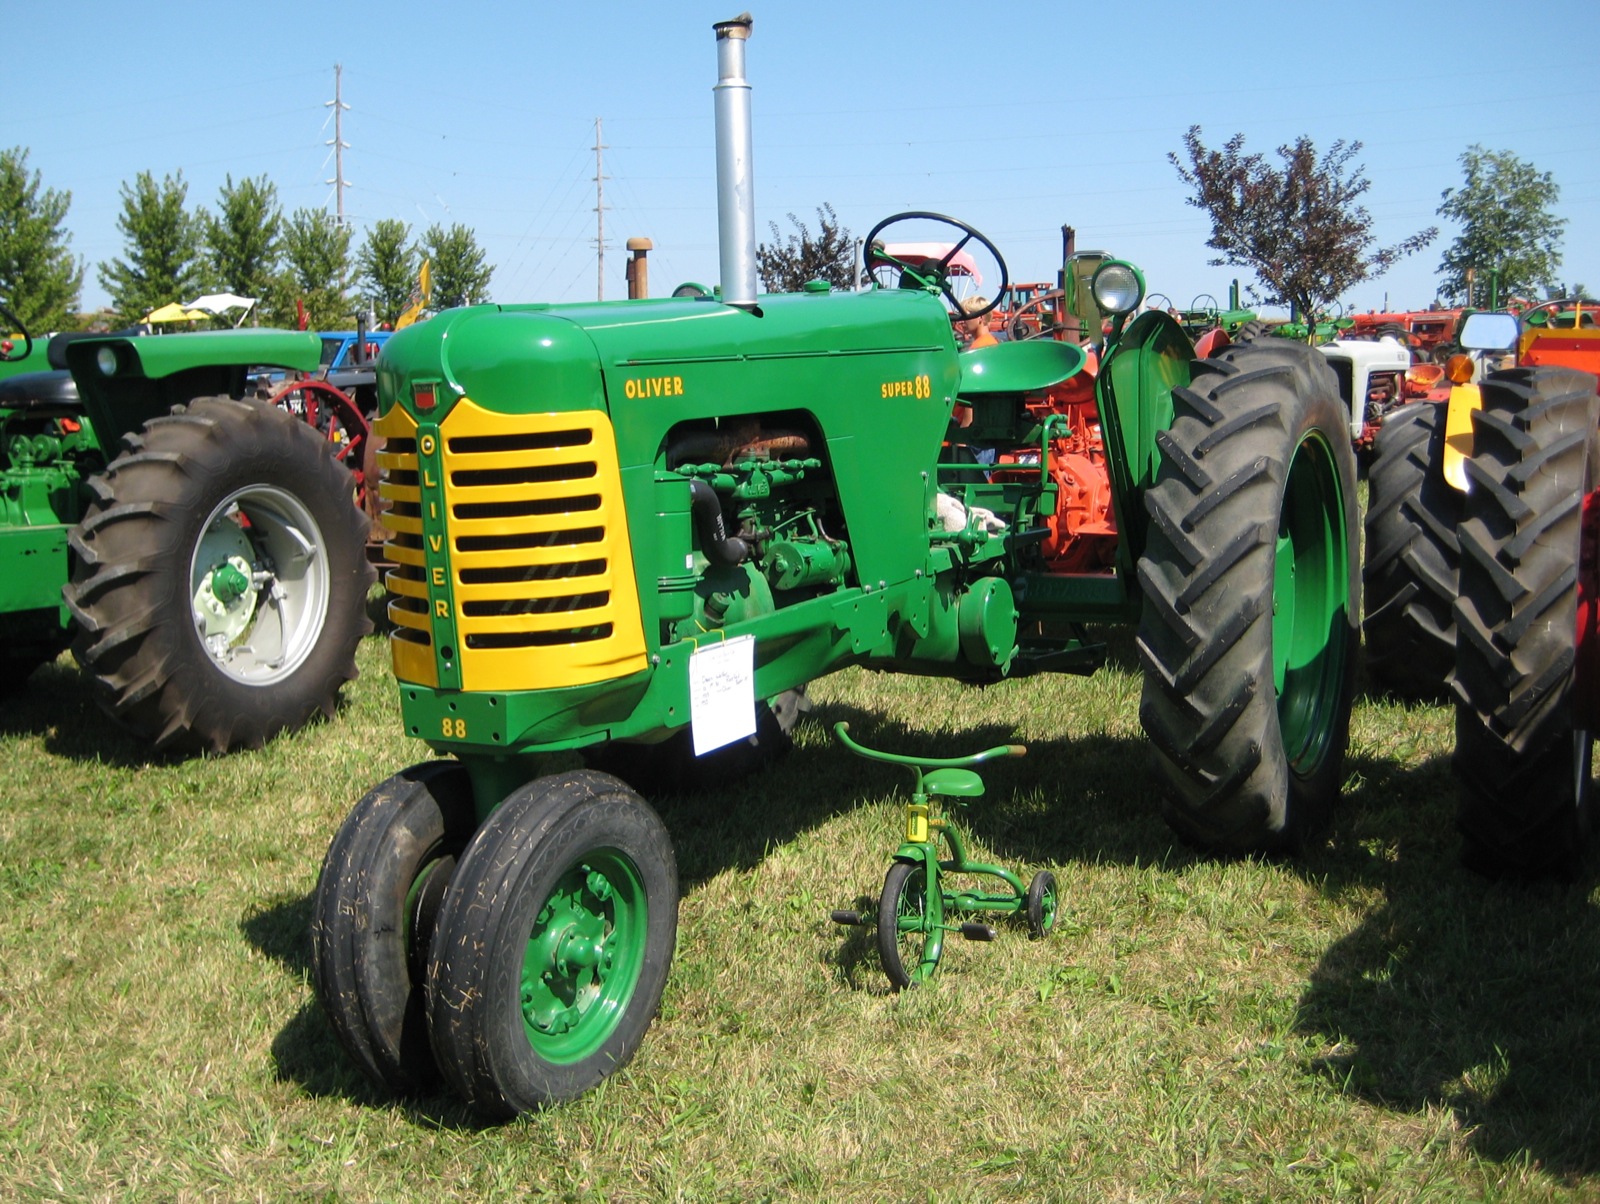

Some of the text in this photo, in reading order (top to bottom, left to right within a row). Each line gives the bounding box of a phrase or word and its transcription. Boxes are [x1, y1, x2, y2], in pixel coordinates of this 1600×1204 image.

[625, 376, 684, 399] OLIVER
[881, 374, 931, 400] SUPER 88
[420, 434, 449, 618] OLIVER
[441, 717, 467, 738] 88
